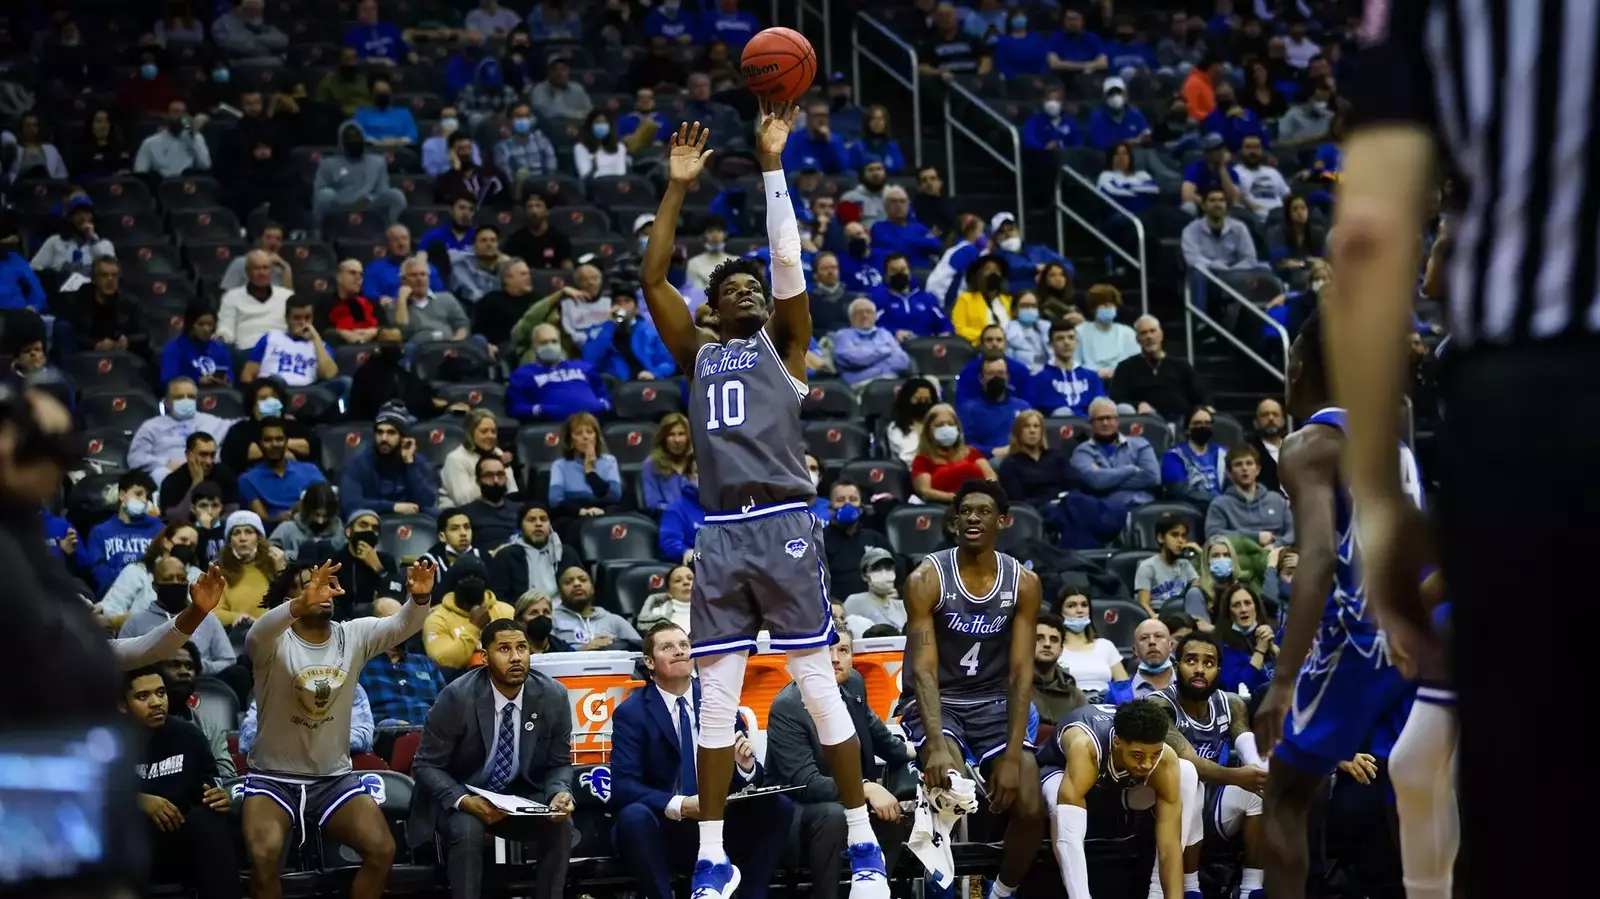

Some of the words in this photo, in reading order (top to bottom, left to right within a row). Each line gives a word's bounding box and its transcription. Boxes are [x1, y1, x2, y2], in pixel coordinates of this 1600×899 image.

[699, 356, 718, 379] The
[717, 350, 759, 372] Hall
[706, 379, 746, 431] 10
[944, 611, 970, 634] The
[969, 613, 1008, 635] Hall
[959, 640, 982, 677] 4
[582, 691, 609, 723] G
